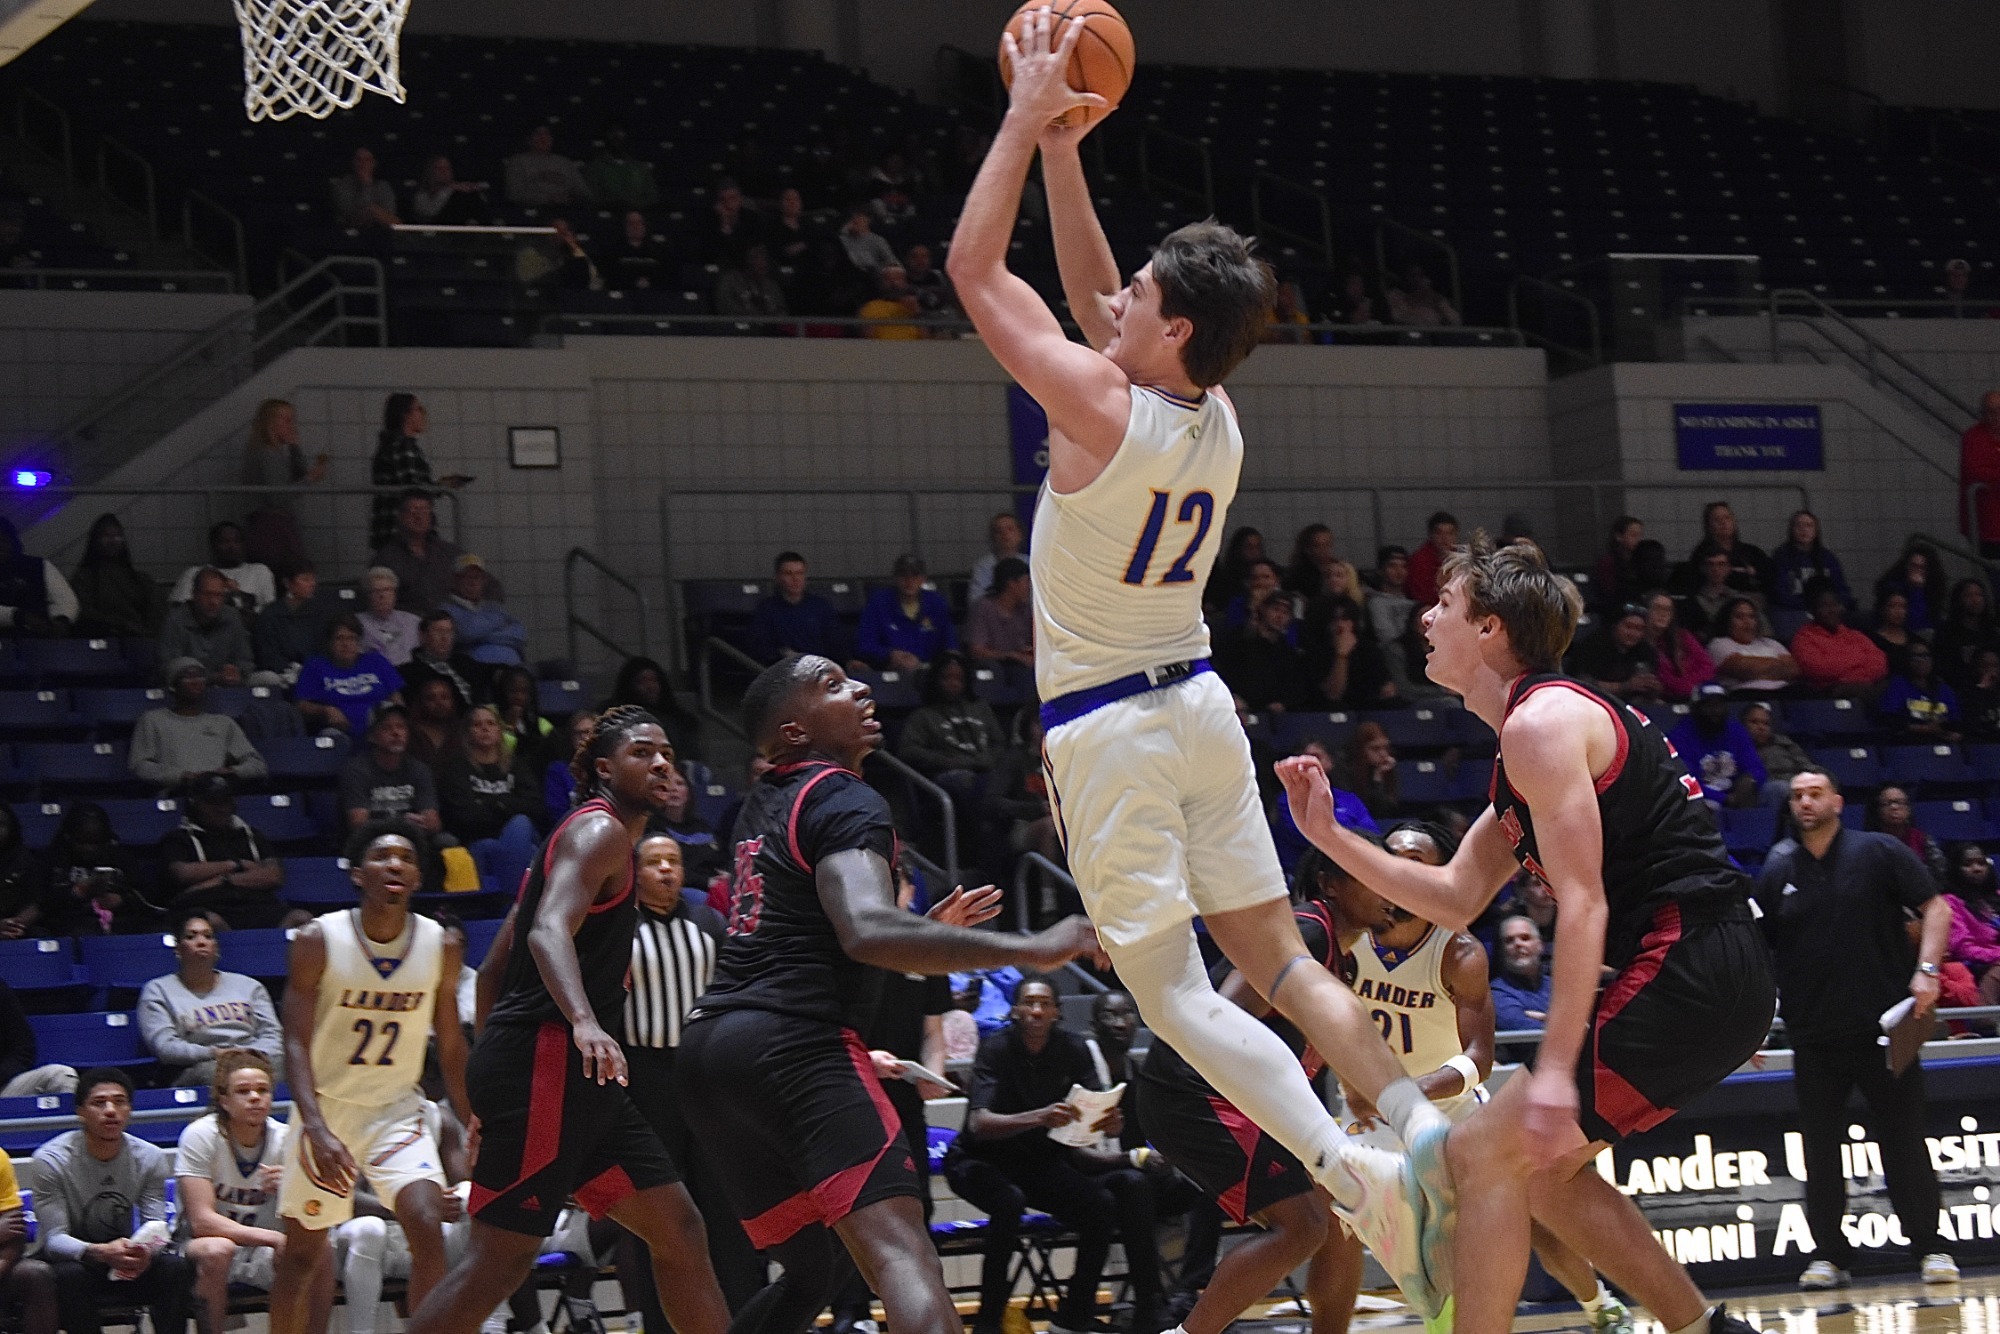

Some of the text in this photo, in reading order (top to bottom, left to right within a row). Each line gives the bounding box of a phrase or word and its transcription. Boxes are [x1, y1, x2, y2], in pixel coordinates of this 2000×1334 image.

[1120, 487, 1215, 587] 12
[338, 989, 425, 1012] LANDER
[1352, 978, 1436, 1009] ANDER
[181, 1001, 254, 1032] ANDER
[347, 1018, 402, 1066] 22
